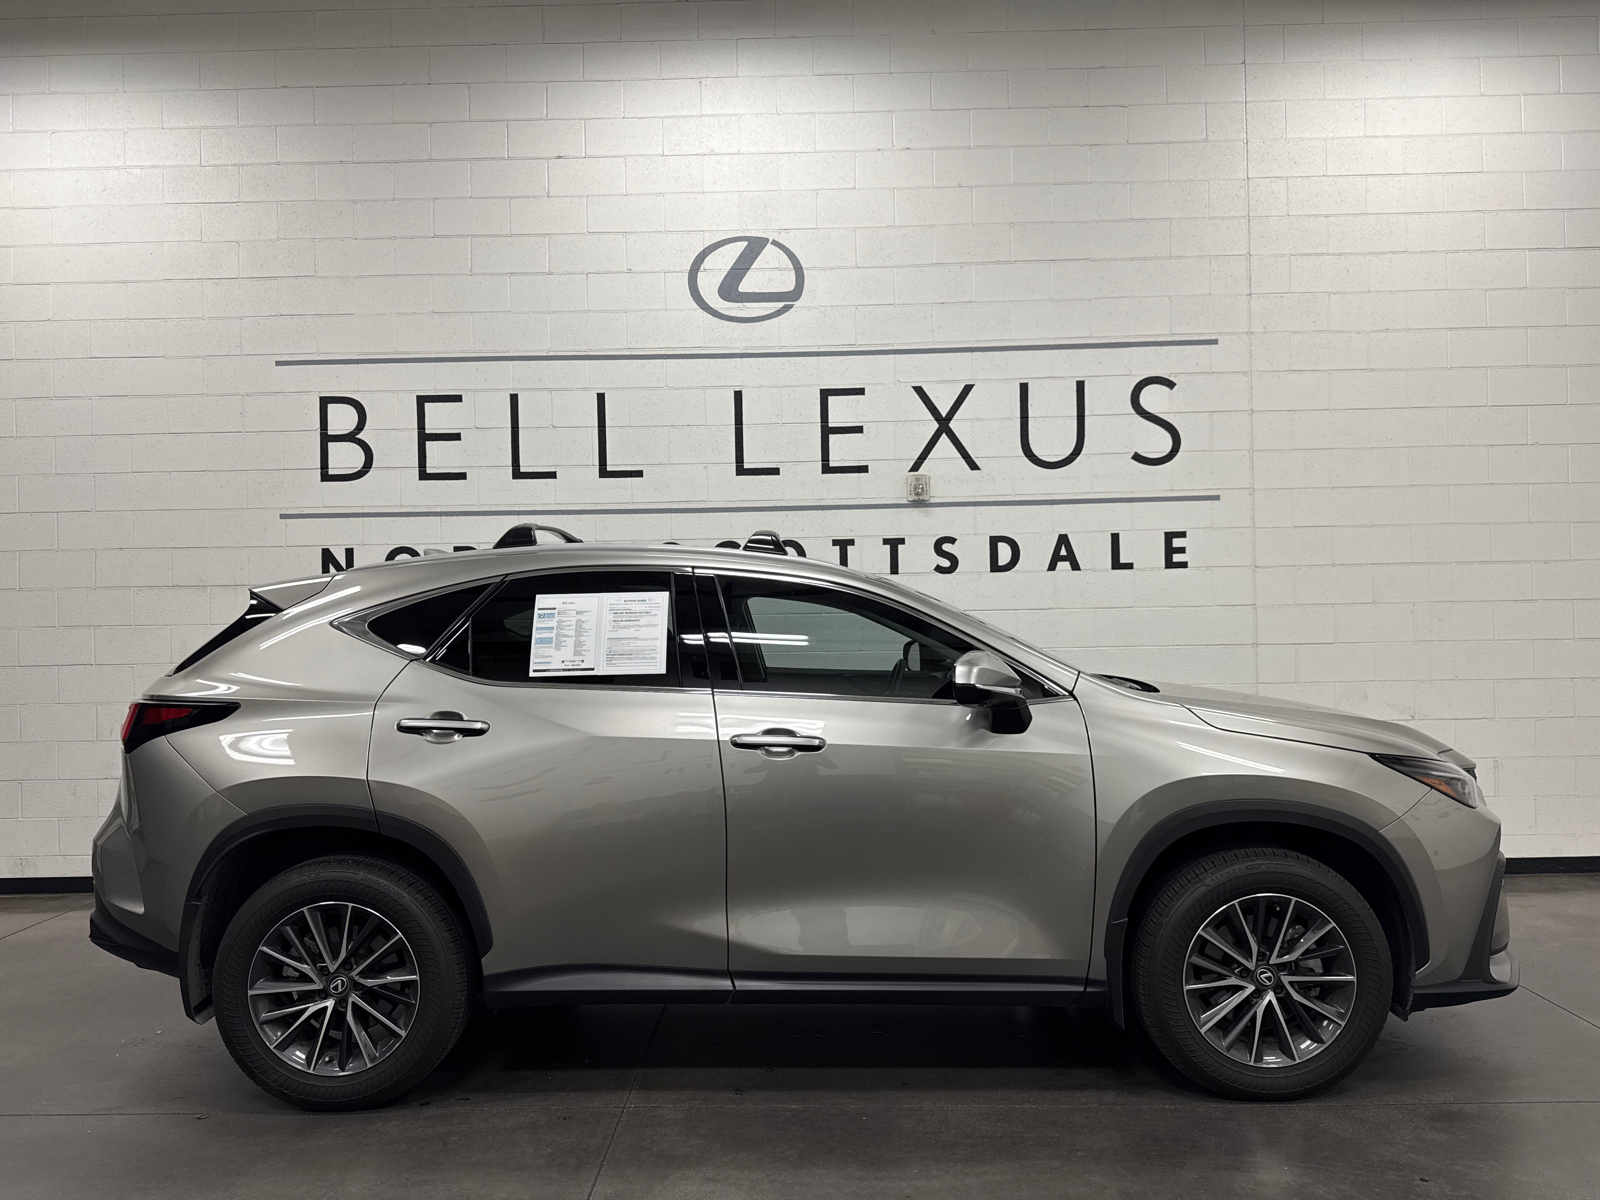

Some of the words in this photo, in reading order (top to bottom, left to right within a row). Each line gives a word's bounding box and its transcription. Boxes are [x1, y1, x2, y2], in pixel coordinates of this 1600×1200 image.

[319, 392, 643, 482] BELL
[734, 375, 1181, 476] LEXUS
[663, 531, 1190, 575] TTSDALE
[361, 874, 407, 900] BRIDGESTONE
